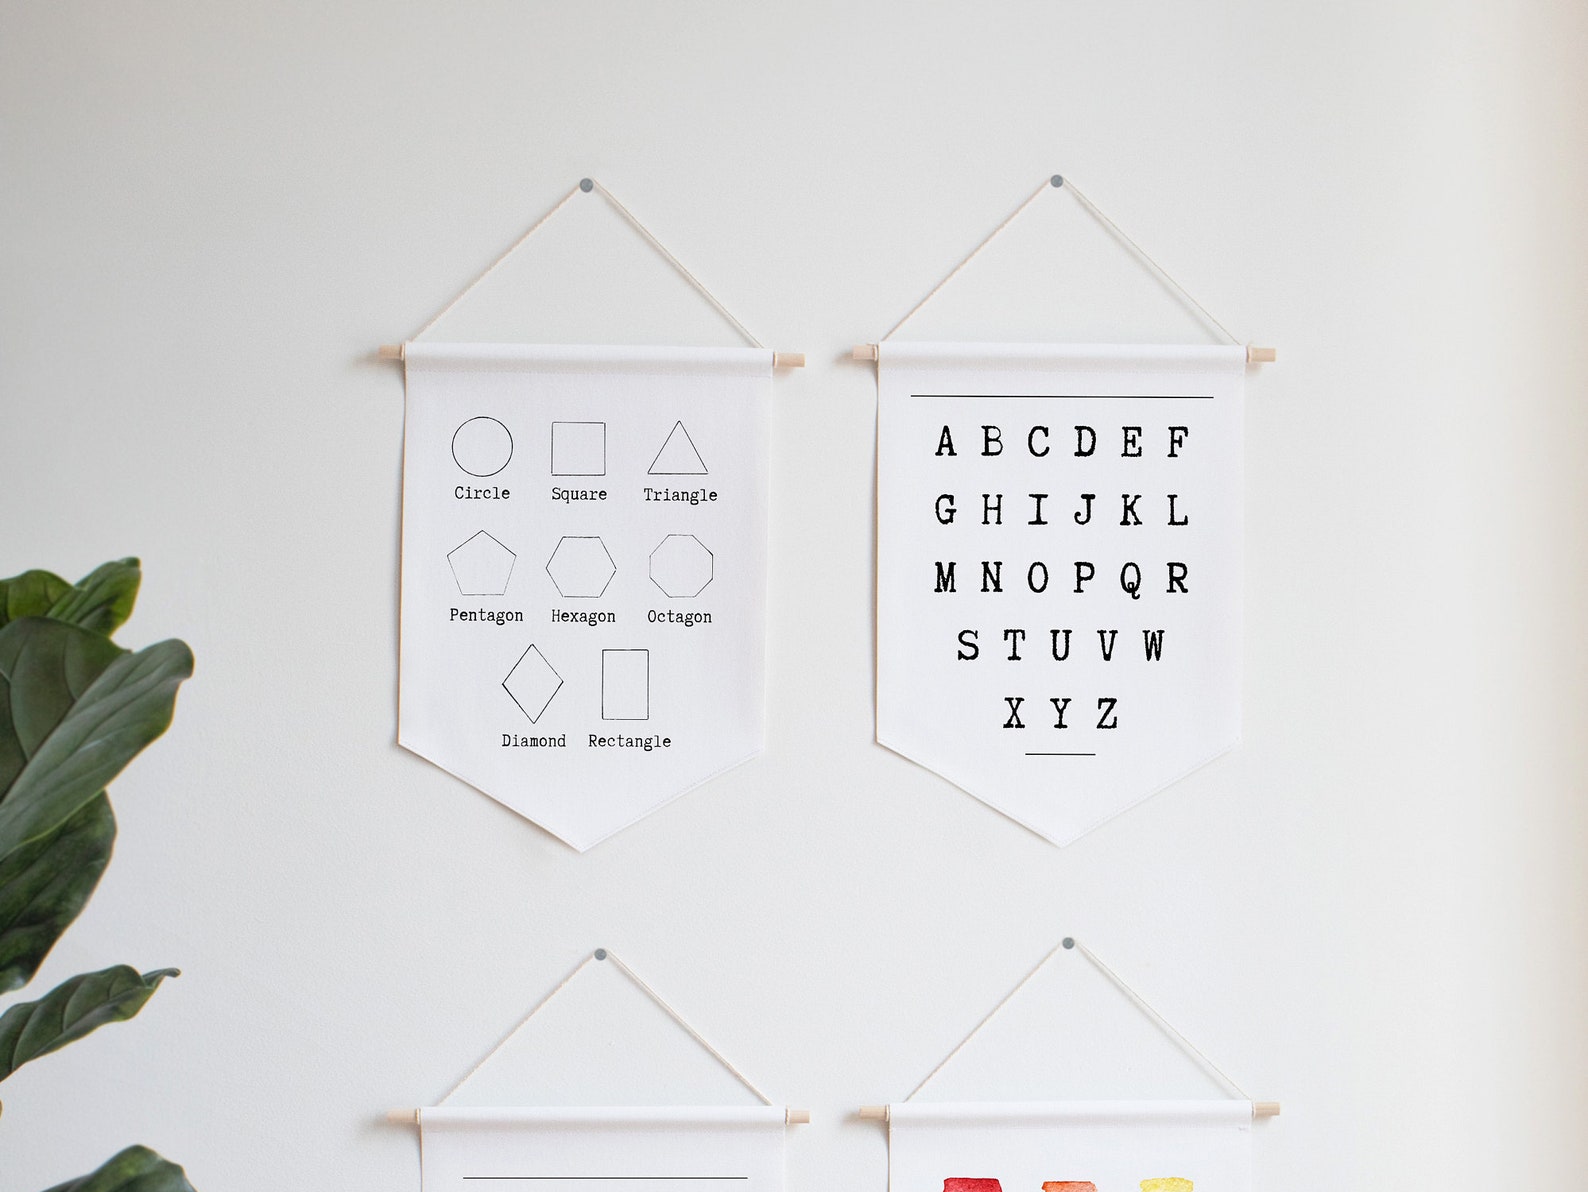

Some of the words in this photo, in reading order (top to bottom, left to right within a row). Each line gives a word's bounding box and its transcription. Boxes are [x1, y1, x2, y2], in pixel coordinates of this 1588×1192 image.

[934, 424, 958, 457] A
[980, 425, 1004, 457] B
[1027, 425, 1051, 458] C
[1073, 425, 1097, 458] D
[1120, 425, 1143, 458] E
[1166, 425, 1189, 458] F
[454, 485, 511, 500] Circle
[551, 486, 608, 505] Square
[643, 487, 718, 506] Triangle
[934, 493, 958, 526] G
[981, 493, 1003, 526] H
[1027, 493, 1049, 526] I
[1073, 493, 1096, 526] J
[1119, 493, 1143, 527] K
[1166, 493, 1189, 527] L
[933, 561, 957, 594] M
[980, 560, 1004, 593] N
[1027, 561, 1049, 594] O
[1073, 561, 1096, 594] P
[1119, 561, 1142, 601] Q
[1165, 561, 1189, 594] R
[449, 607, 524, 626] Pentagon
[551, 608, 616, 627] Hexagon
[647, 609, 712, 628] Octagon
[957, 629, 980, 661] S
[1003, 628, 1026, 662] T
[1049, 629, 1073, 662] U
[1096, 629, 1119, 662] V
[1141, 629, 1166, 662] W
[1002, 696, 1026, 729] X
[1049, 697, 1072, 730] Y
[1096, 697, 1118, 730] Z
[501, 733, 566, 748] Diamond
[588, 733, 672, 752] Rectangle
